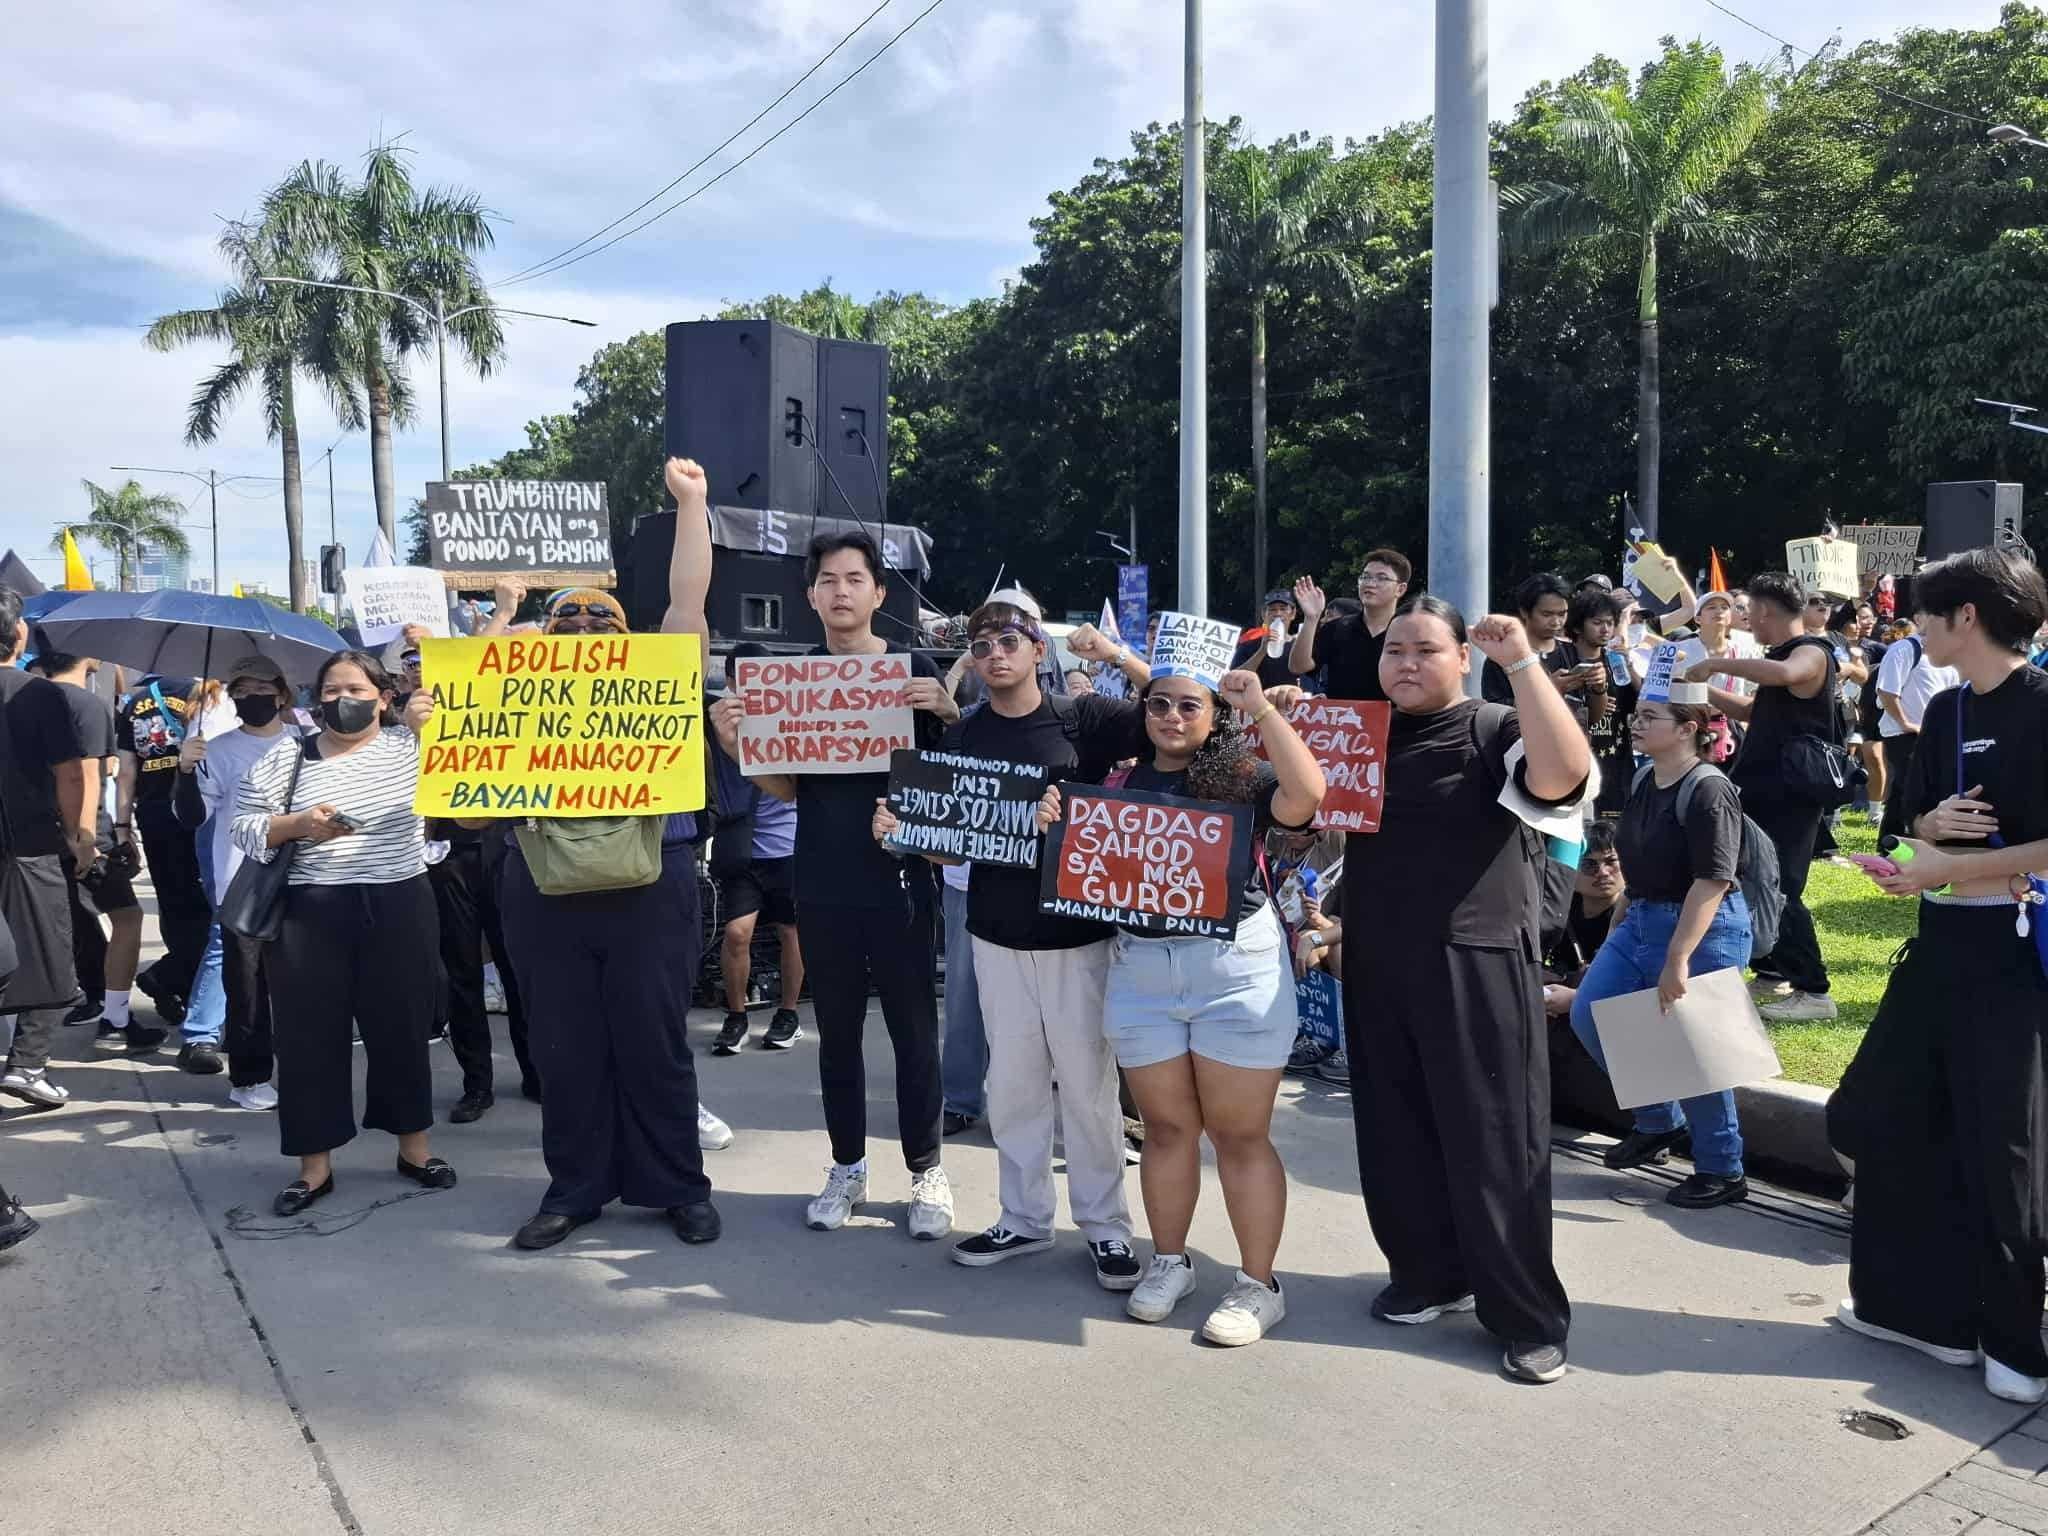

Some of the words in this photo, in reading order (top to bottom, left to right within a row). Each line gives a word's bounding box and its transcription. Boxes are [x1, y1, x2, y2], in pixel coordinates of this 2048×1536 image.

[448, 480, 601, 512] TAUMBAYAN
[432, 511, 562, 539] BANTAYAN
[443, 538, 511, 563] PONDO
[515, 546, 537, 565] ng
[541, 539, 610, 564] BAYAN
[1865, 551, 1916, 575] DRAMA
[365, 617, 387, 629] SA
[1162, 616, 1239, 642] LAHAT
[478, 639, 630, 675] ABOLISH
[1156, 638, 1230, 661] SANGKOT
[738, 659, 863, 687] PONDO
[869, 659, 908, 683] SA
[431, 681, 480, 711] ALL
[502, 677, 577, 707] PORK
[590, 671, 697, 707] BARREL!
[743, 686, 911, 717] EDUKASYON
[437, 711, 530, 742] LAHAT
[537, 711, 573, 738] NG
[580, 710, 698, 740] SANGKOT
[778, 720, 836, 733] HINDI
[842, 720, 869, 731] SA
[424, 744, 516, 775] DAPAT
[527, 741, 683, 774] MANAGOT!
[741, 735, 909, 766] KORAPSYON
[953, 773, 1000, 797] LIN!
[1015, 765, 1043, 779] PNU
[1070, 799, 1224, 844] DAGDAG
[965, 826, 1038, 865] DUTERTE,
[1074, 826, 1193, 867] SAHOD
[1067, 852, 1109, 876] SA
[1143, 862, 1204, 890] MGA
[1082, 876, 1204, 917] GURO!
[1308, 1003, 1324, 1017] SA
